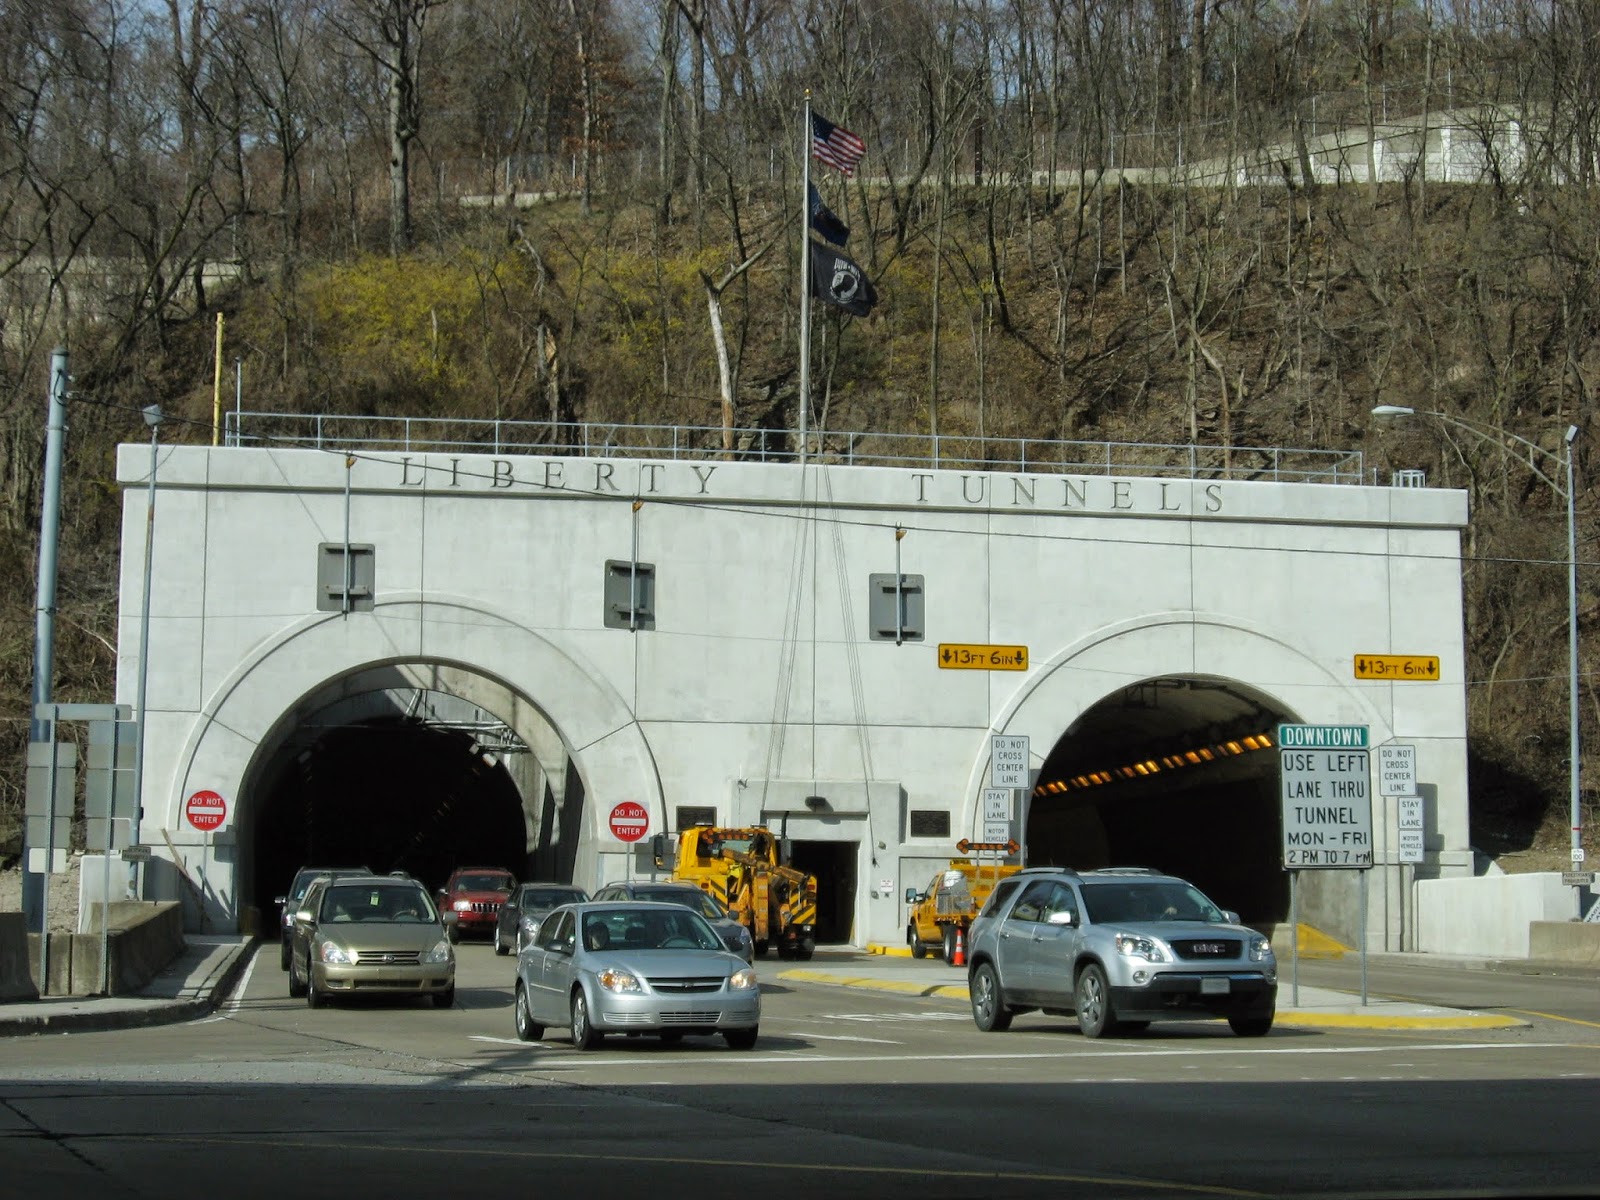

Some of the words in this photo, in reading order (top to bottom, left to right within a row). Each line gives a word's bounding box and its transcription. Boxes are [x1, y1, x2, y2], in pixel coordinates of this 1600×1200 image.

[400, 457, 718, 494] LIBERTY
[911, 473, 1223, 512] TUNNELS
[953, 650, 985, 664] 13FT
[1368, 660, 1399, 674] 13FT
[1286, 727, 1362, 746] DOWNTOWN
[995, 740, 1006, 749] DO
[1010, 740, 1025, 749] NOT
[998, 751, 1022, 760] CROSS
[1382, 750, 1393, 758] DO
[1397, 750, 1411, 758] NOT
[996, 763, 1024, 772] CENTER
[1284, 754, 1315, 771] USE
[1327, 755, 1366, 772] LEFT
[1385, 760, 1409, 769] CROSS
[1002, 775, 1019, 784] LINE
[1384, 772, 1411, 780] CENTER
[1287, 781, 1322, 799] LANE
[1331, 781, 1365, 798] THRU
[1389, 783, 1406, 792] LINE
[628, 809, 644, 817] NOT
[1295, 807, 1358, 825] TUNNEL
[193, 816, 218, 824] ENTER
[1401, 819, 1421, 827] LANE
[616, 827, 641, 836] ENTER
[1288, 832, 1324, 845] MON
[1342, 832, 1367, 845] FRI
[1288, 850, 1297, 863] 2
[1302, 850, 1319, 863] PM
[1324, 850, 1338, 863] TO
[1343, 851, 1350, 863] 7
